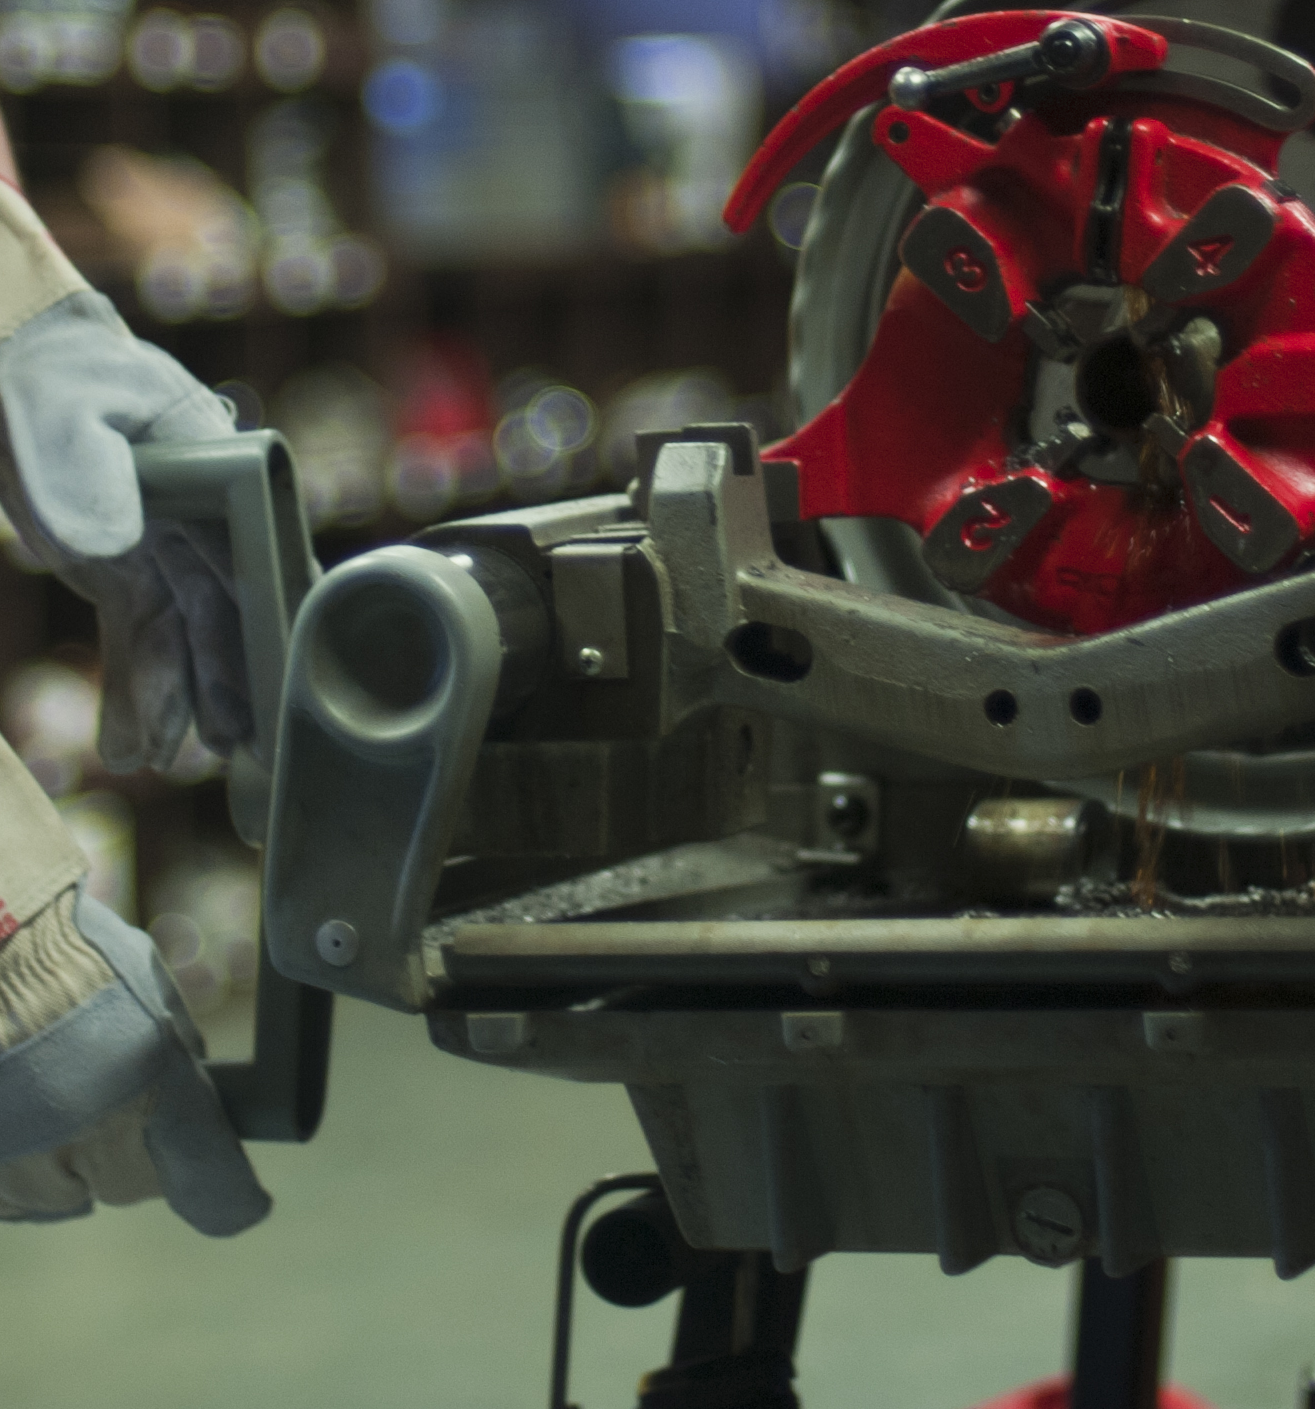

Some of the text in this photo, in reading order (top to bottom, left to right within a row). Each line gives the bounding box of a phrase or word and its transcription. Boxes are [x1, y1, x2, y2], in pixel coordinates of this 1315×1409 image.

[943, 245, 987, 292] 3
[1186, 234, 1234, 277] 4
[960, 497, 1012, 551] 2
[1208, 494, 1252, 535] 1
